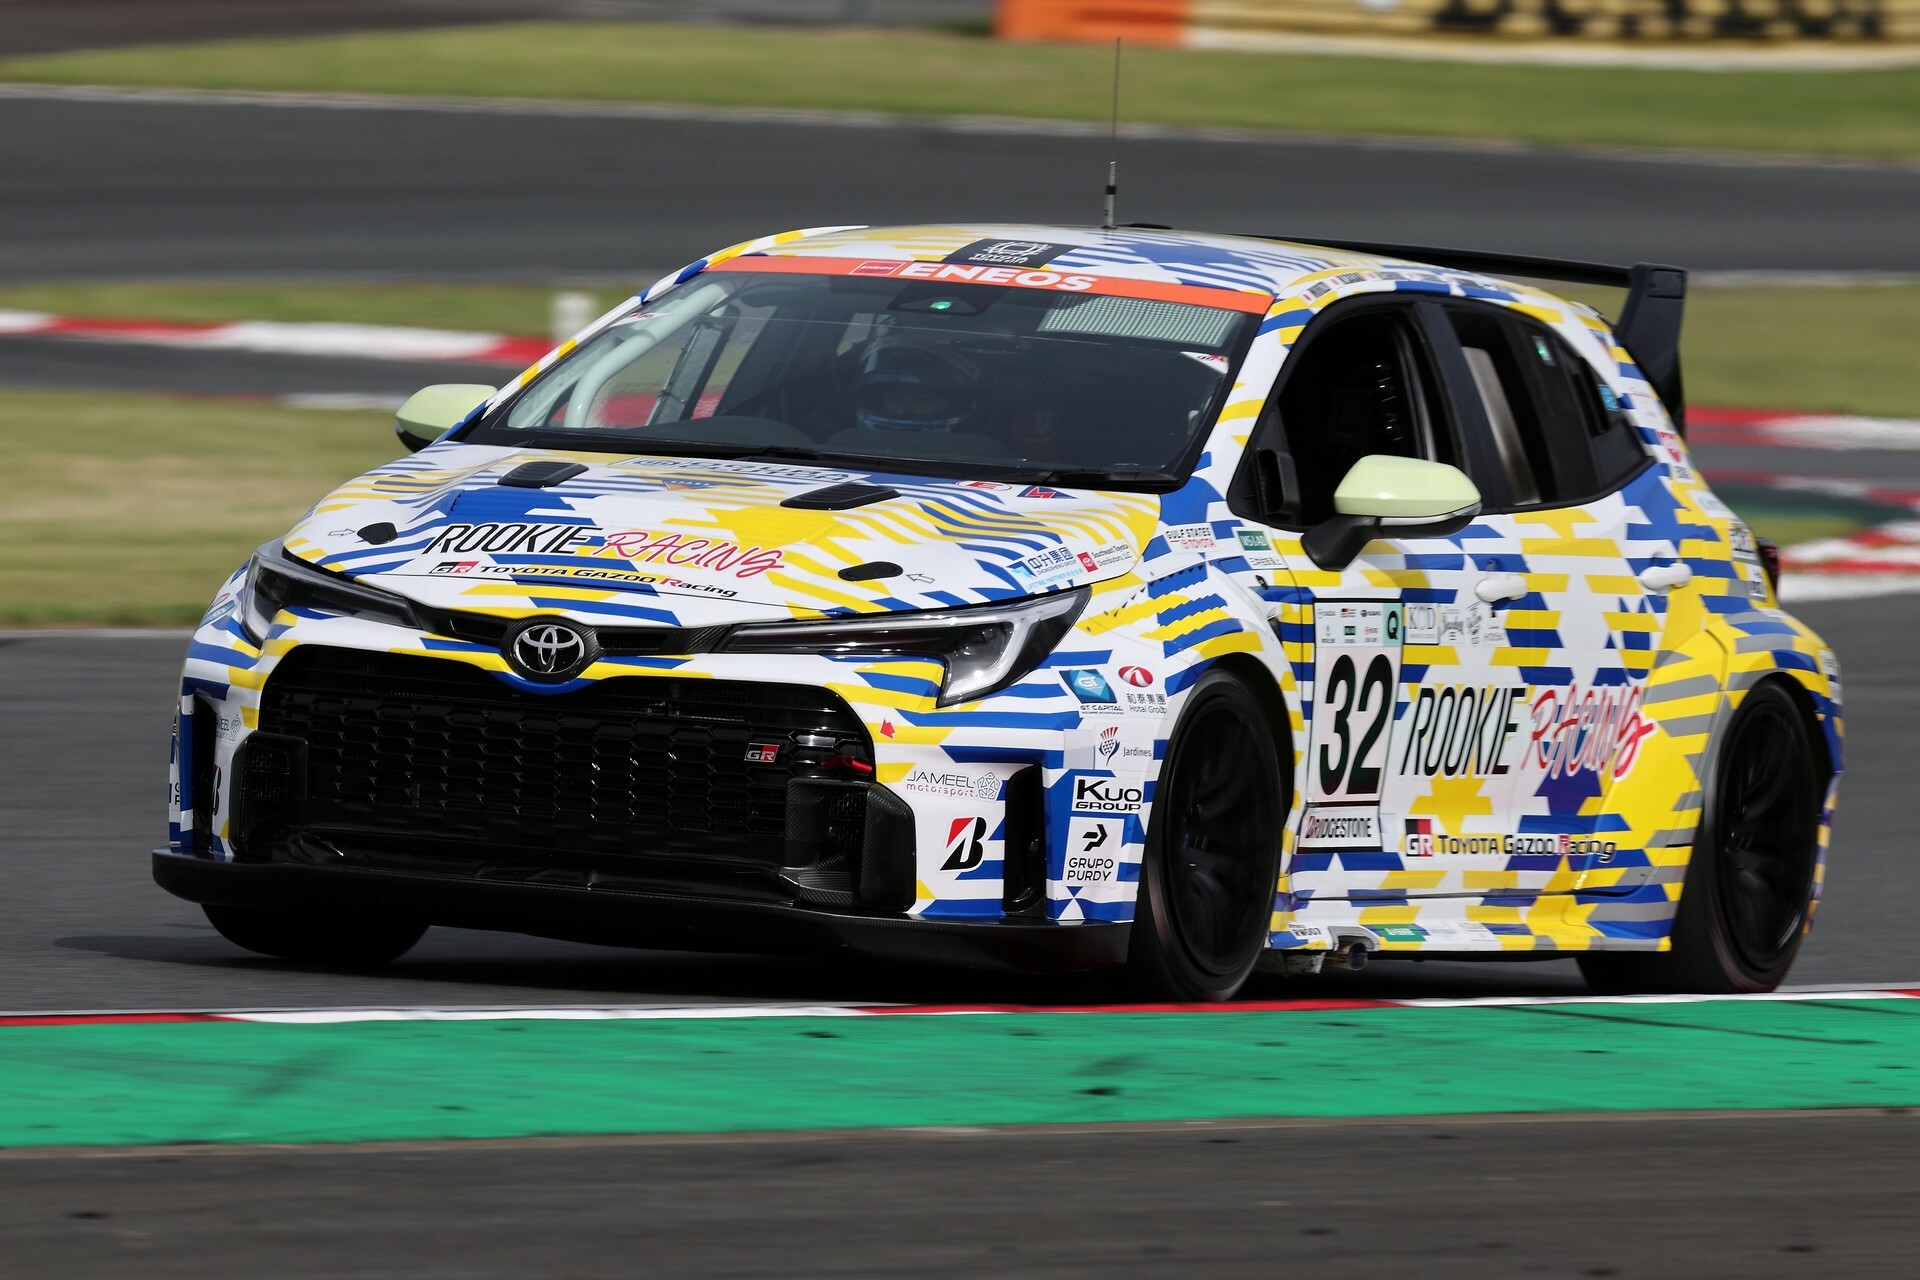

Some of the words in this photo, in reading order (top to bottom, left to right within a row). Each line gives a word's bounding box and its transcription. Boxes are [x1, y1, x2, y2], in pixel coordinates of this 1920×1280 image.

[898, 262, 1100, 291] ENEOS
[1186, 527, 1211, 538] STATES
[422, 524, 603, 555] ROOKIE
[594, 531, 785, 578] RACING
[430, 563, 475, 574] GR
[480, 565, 569, 576] TOYOTA
[573, 569, 657, 583] GAZOO
[659, 577, 738, 598] Racing
[1387, 610, 1399, 640] Q
[1077, 676, 1101, 689] GT
[1093, 704, 1124, 712] CAPITAL
[1129, 705, 1147, 713] Hotai
[1319, 653, 1394, 796] 32
[1399, 686, 1527, 776] ROOKIE
[1520, 684, 1656, 779] RACING
[746, 749, 776, 761] GR
[1123, 746, 1152, 758] Jardines
[906, 770, 975, 789] JAMEEL
[906, 783, 975, 798] motorsport
[1075, 801, 1141, 811] GROUP
[1305, 815, 1372, 839] BRIDGESTONE
[1405, 833, 1434, 857] GR
[1438, 834, 1500, 855] TOYOTA
[1503, 834, 1556, 855] GAZOO
[1558, 834, 1616, 862] Racing
[1068, 857, 1114, 869] GRUPO
[1066, 870, 1112, 881] PURDY
